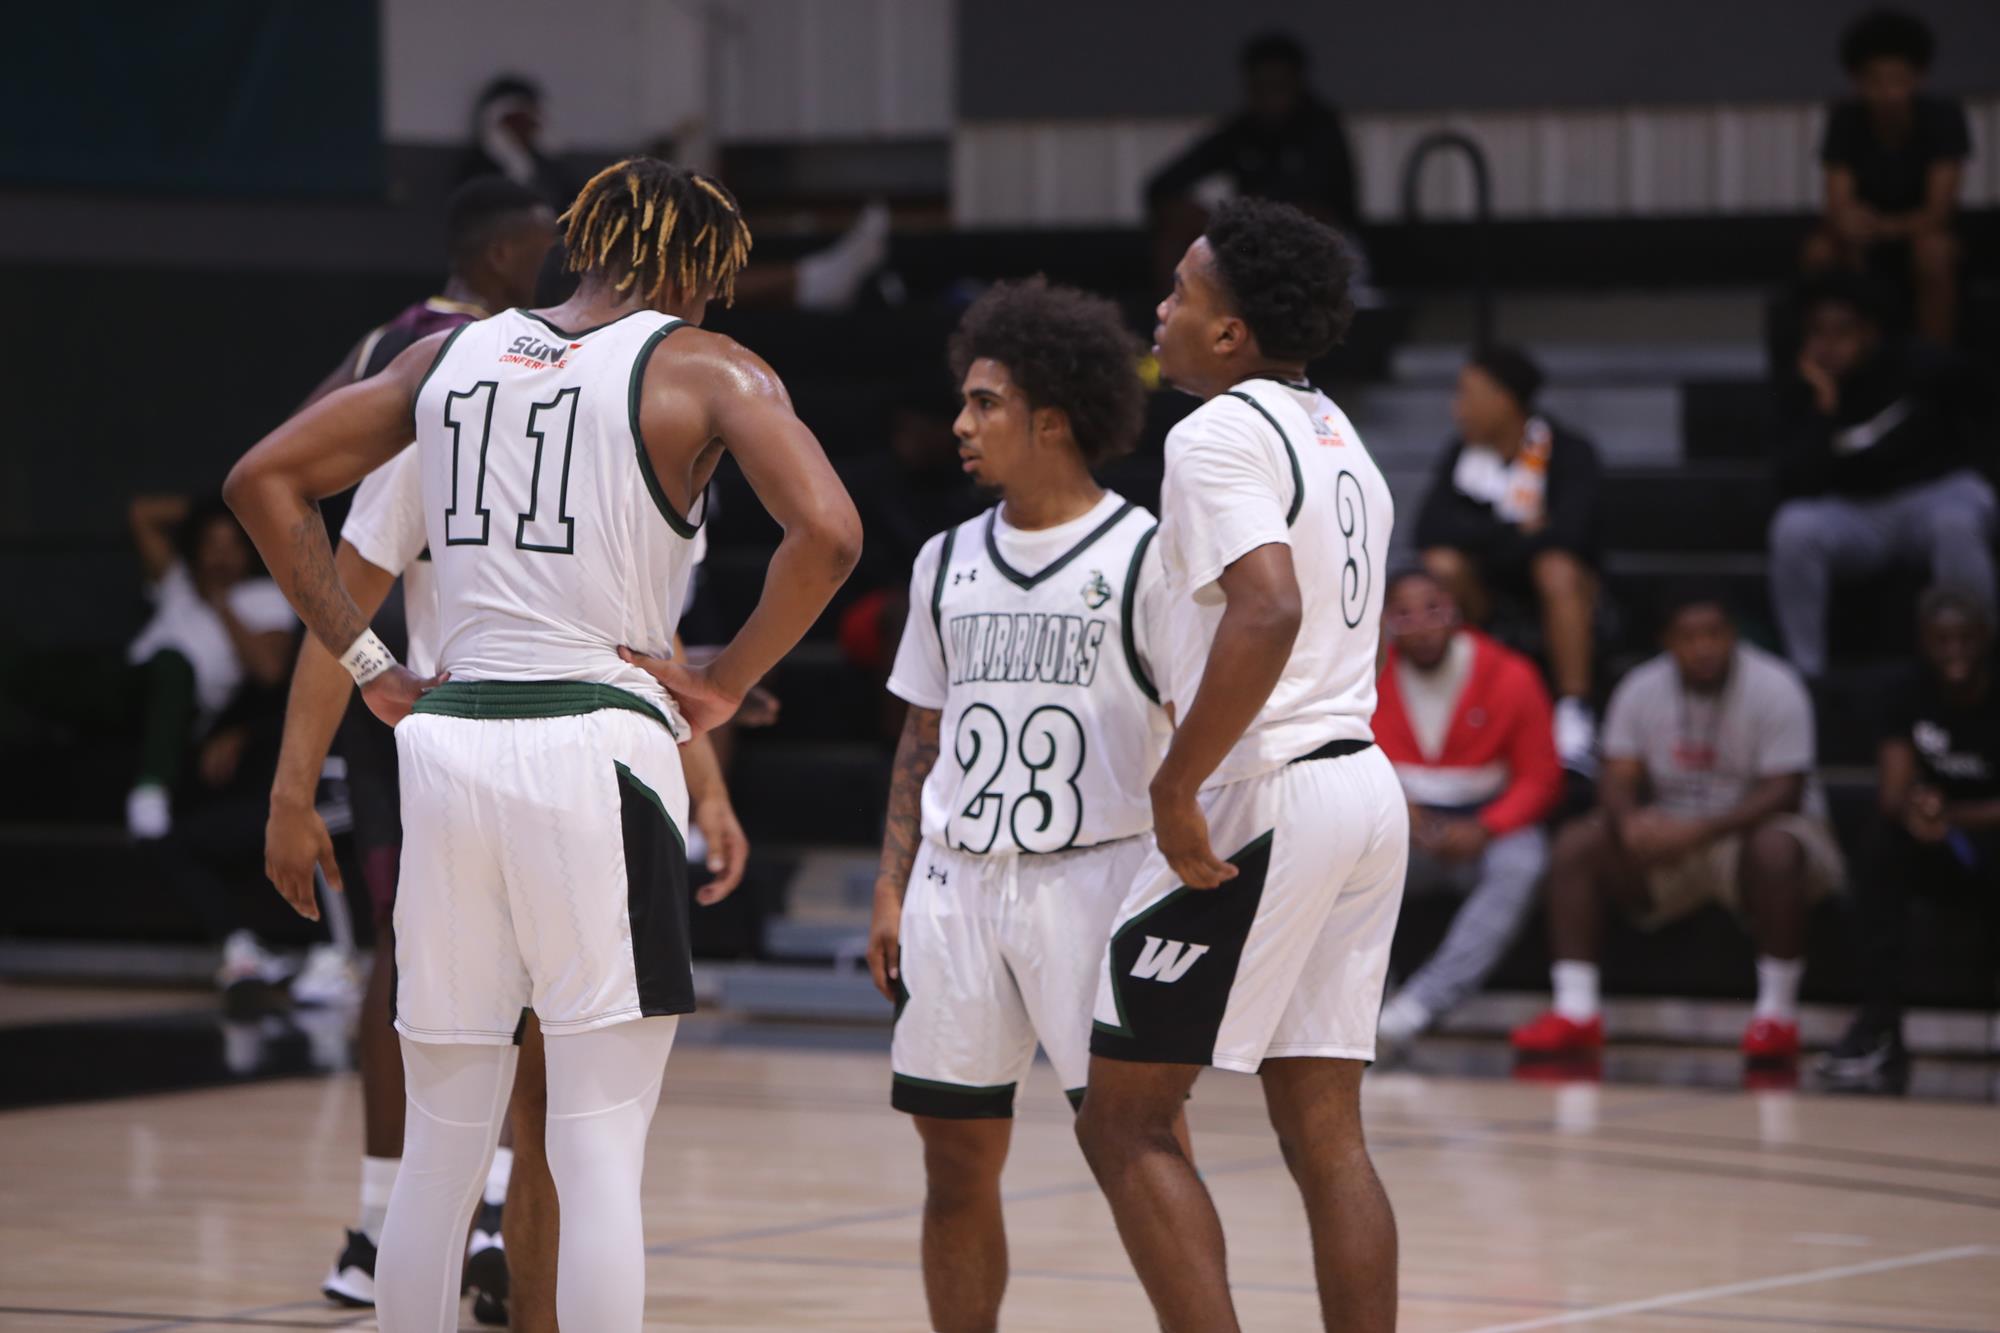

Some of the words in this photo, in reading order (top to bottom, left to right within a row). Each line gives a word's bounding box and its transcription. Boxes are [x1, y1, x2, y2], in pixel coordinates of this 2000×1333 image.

[499, 355, 568, 370] CONFERE
[508, 336, 568, 363] SUN
[444, 381, 581, 555] 11
[1336, 470, 1371, 628] 3
[950, 613, 1106, 687] WARRIORS
[945, 702, 1086, 855] 23
[1129, 935, 1210, 983] W
